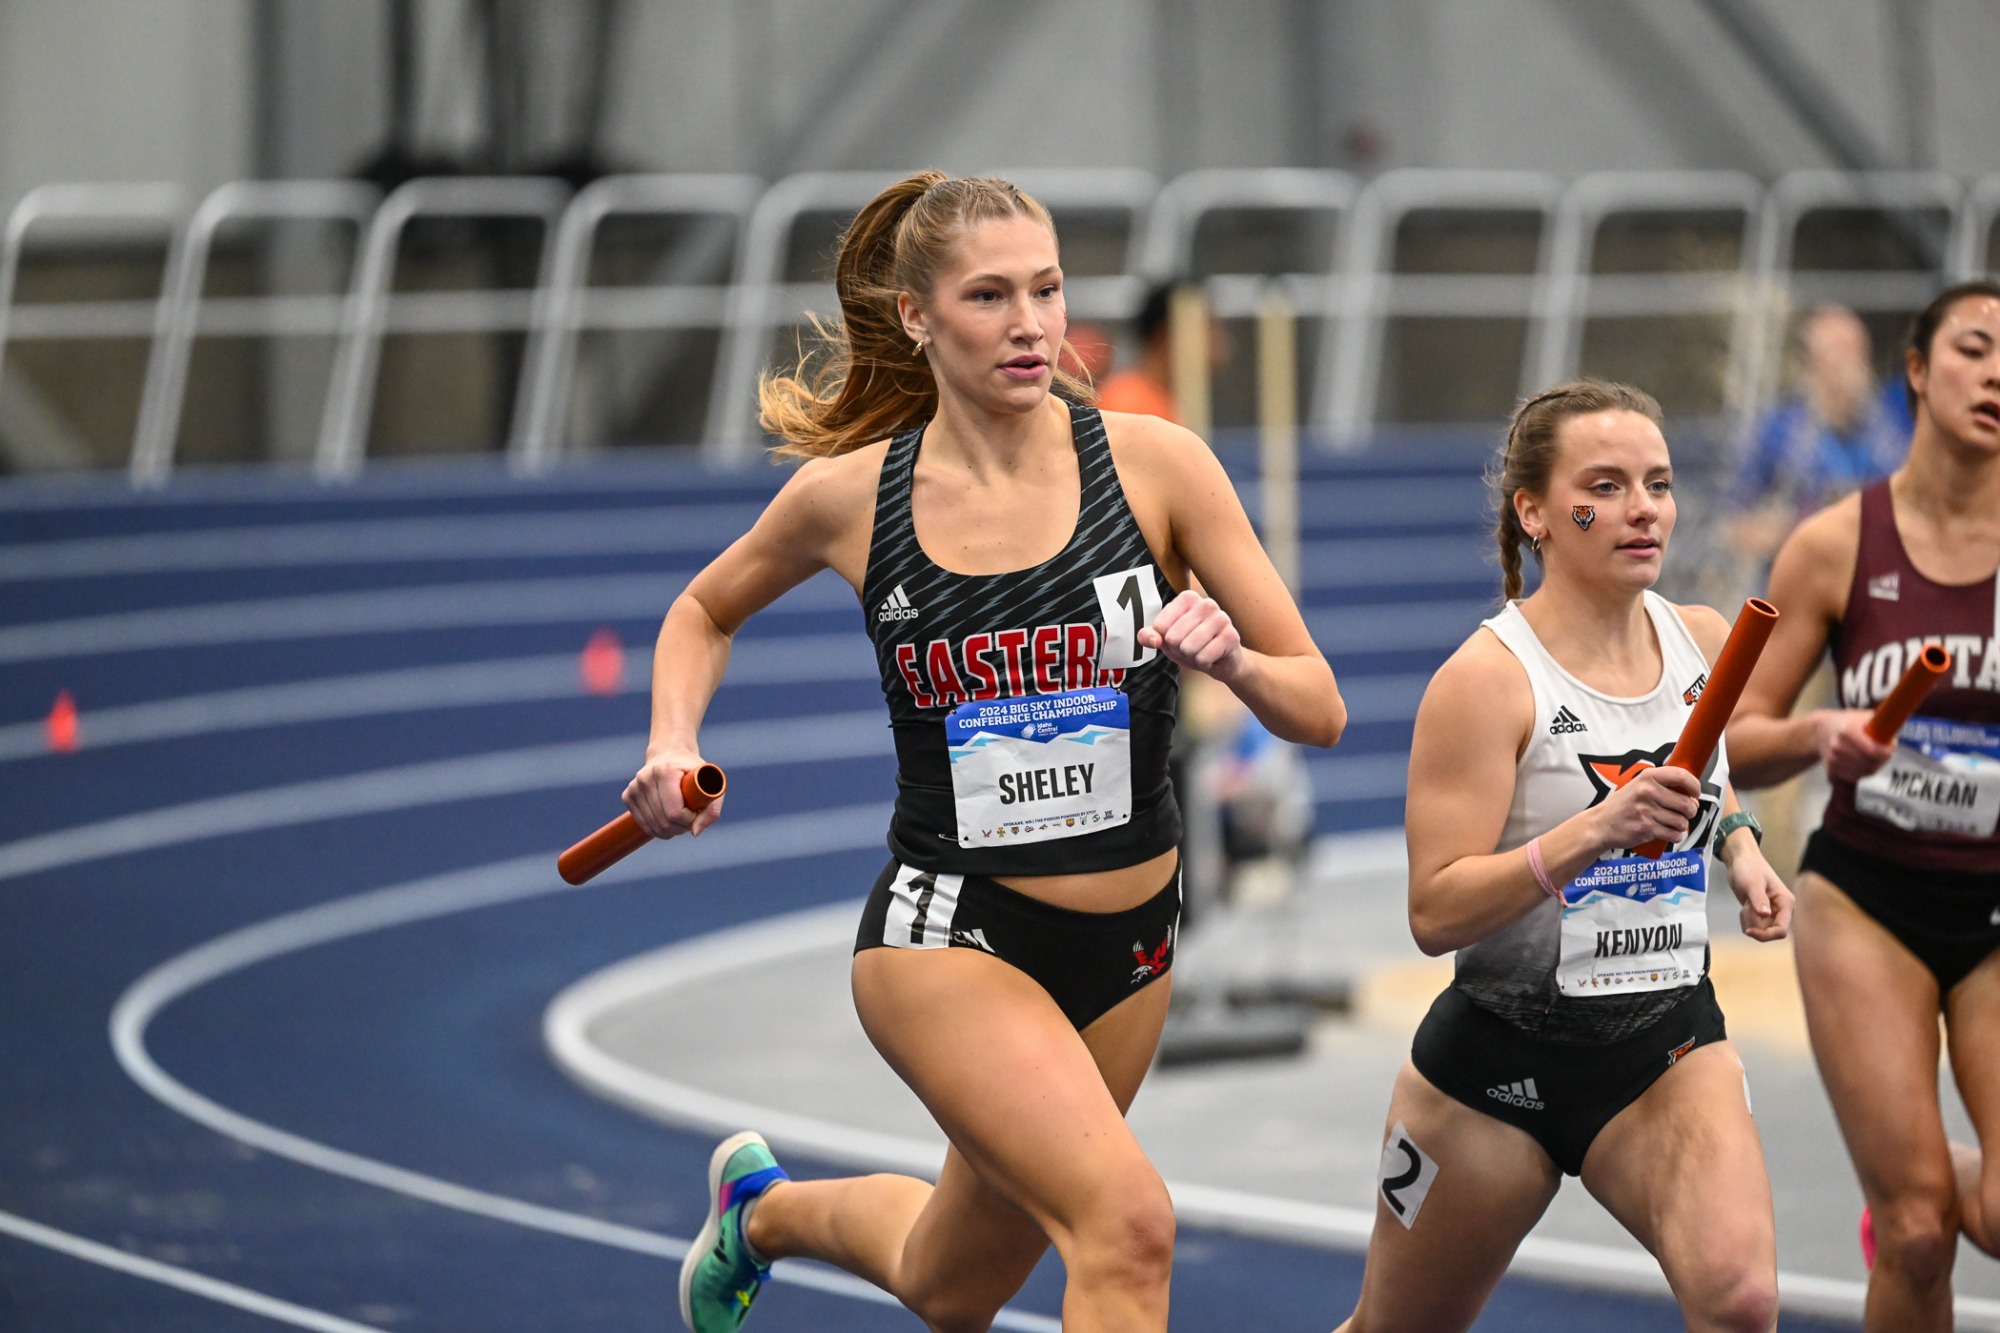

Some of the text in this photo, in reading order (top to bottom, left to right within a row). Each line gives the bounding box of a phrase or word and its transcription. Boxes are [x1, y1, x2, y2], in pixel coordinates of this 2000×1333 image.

[878, 607, 919, 622] adidas
[1116, 574, 1145, 662] 1
[958, 700, 1117, 729] CONFERENCE CHAMPIONSHIP
[979, 694, 1096, 717] 2024 BIG SKY INDOOR
[1549, 721, 1588, 735] addas
[998, 762, 1095, 806] SHELEY
[1574, 863, 1700, 887] CONFERENCE CHAMPIONSHIP
[1594, 857, 1688, 877] 2024 BIG SKY INDOOR
[907, 871, 938, 945] 1
[1594, 922, 1682, 958] KENYON
[1486, 1088, 1545, 1110] adidas
[1381, 1137, 1422, 1217] 2
